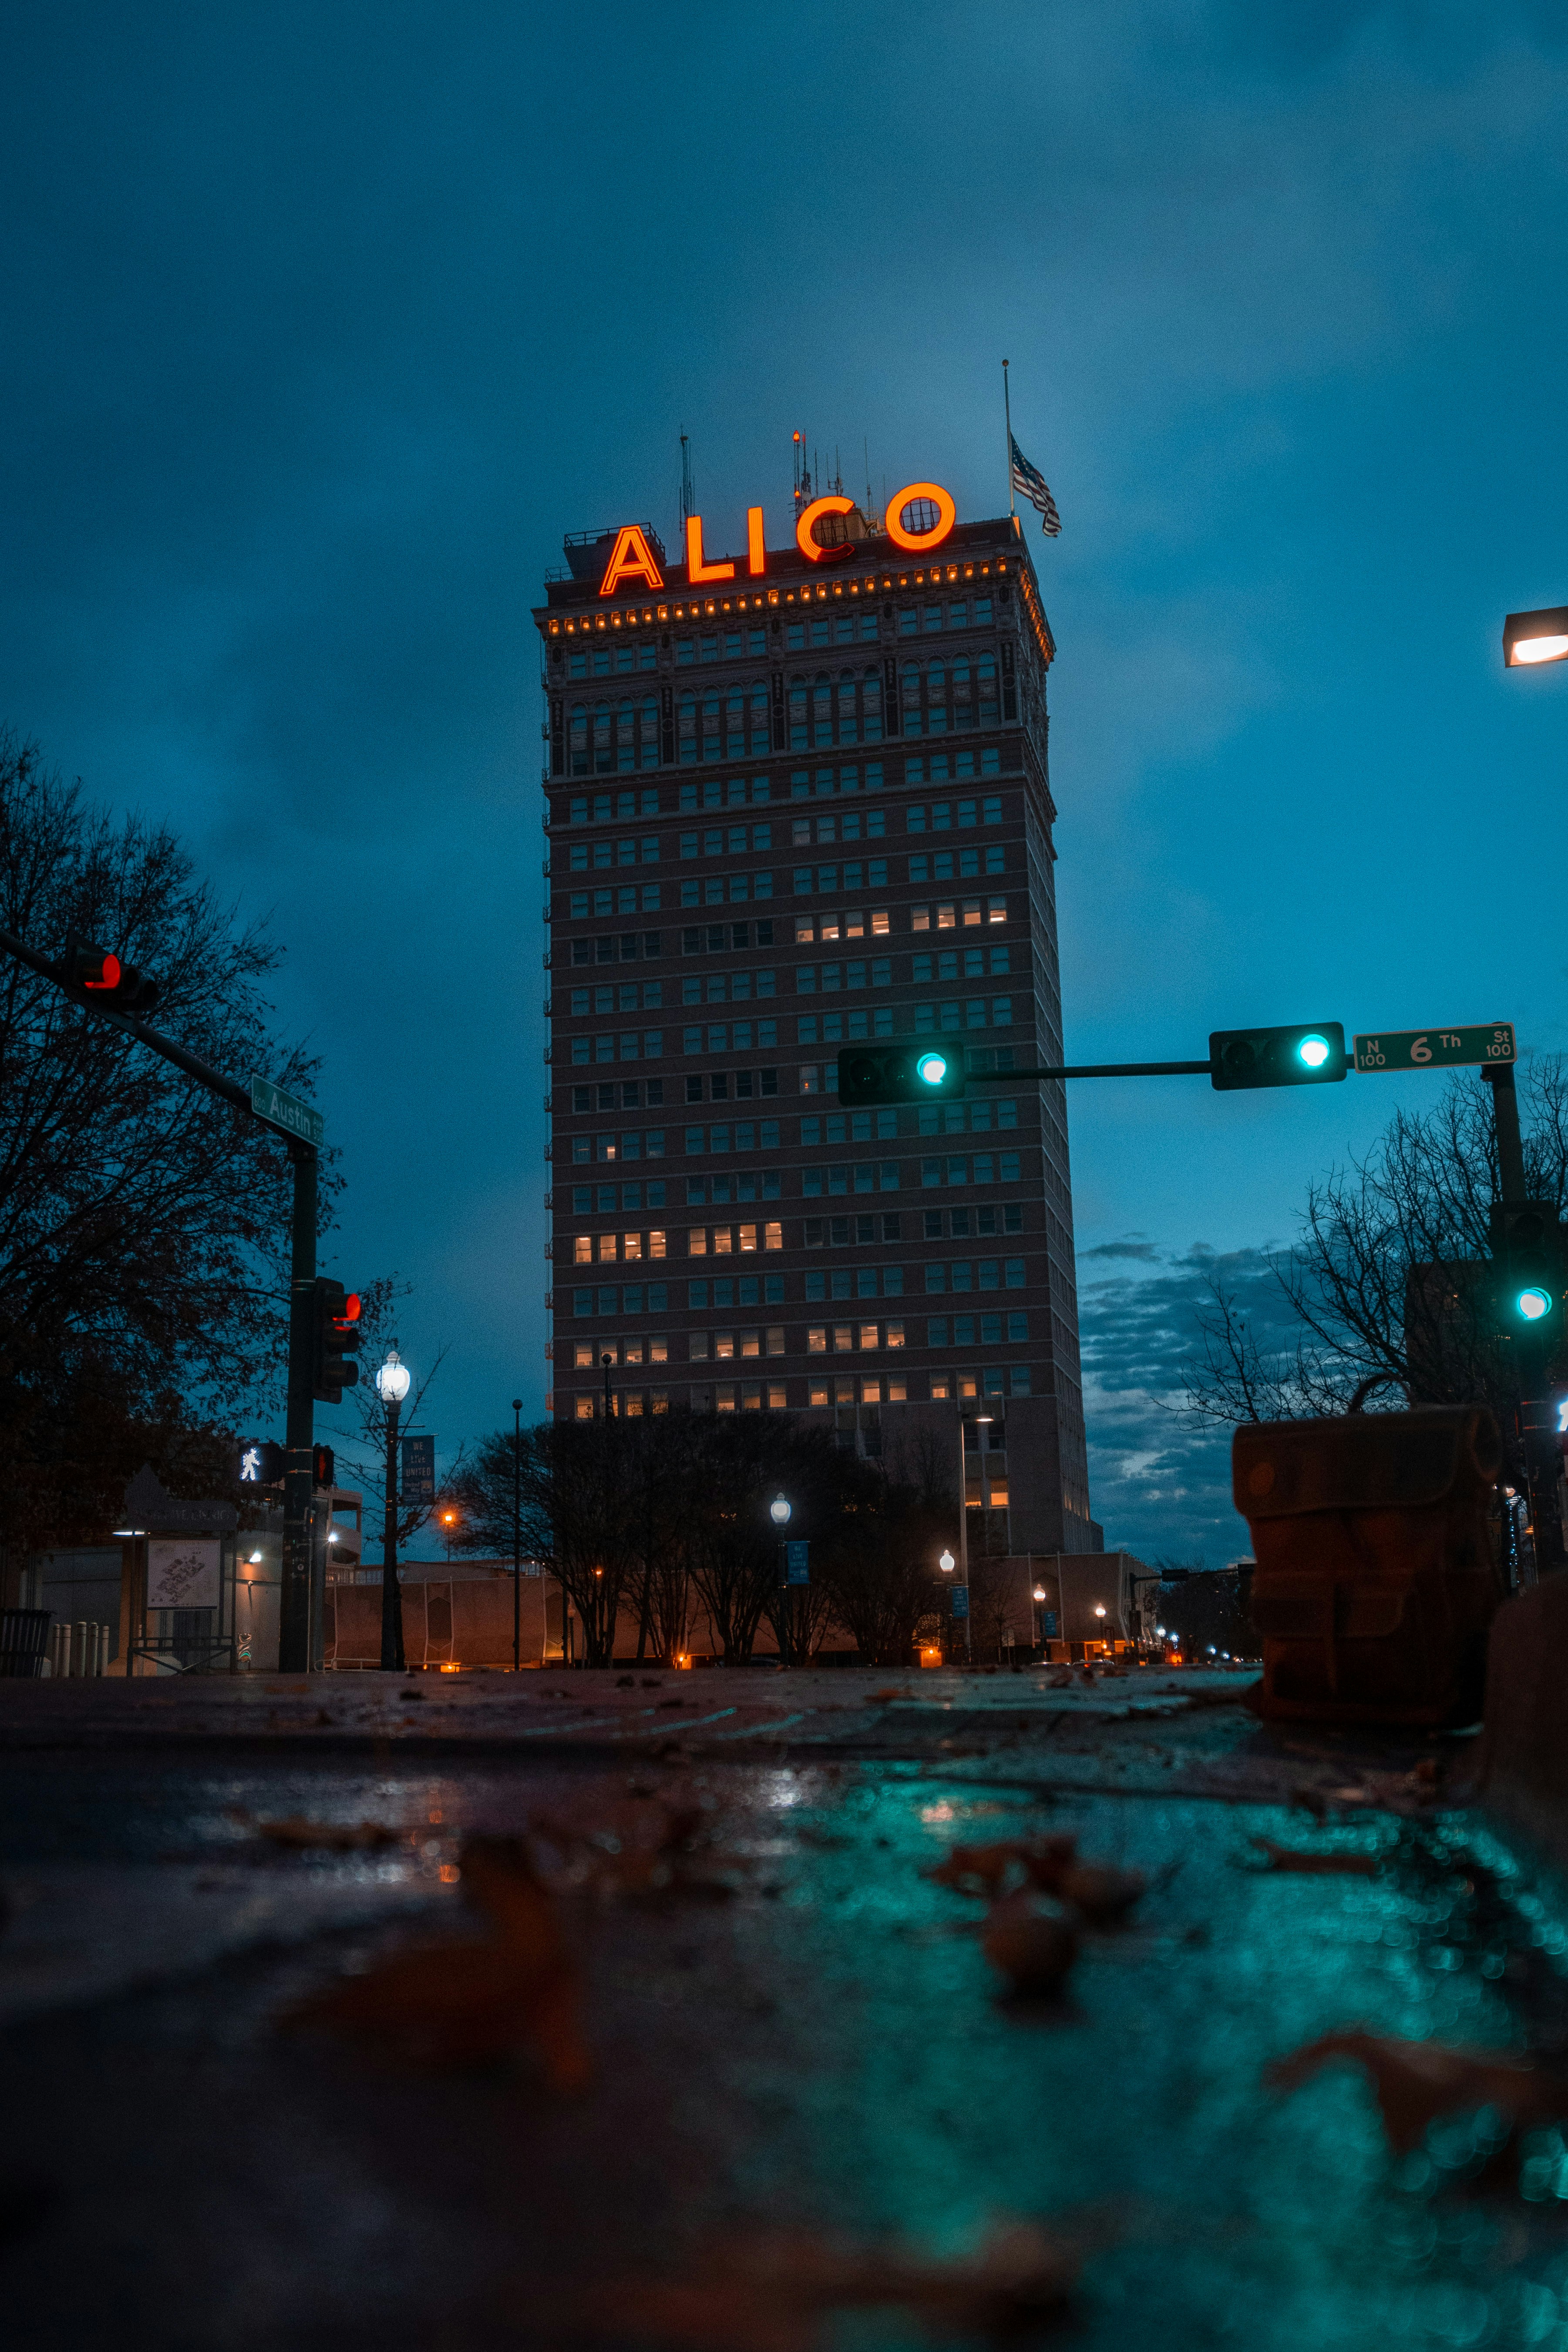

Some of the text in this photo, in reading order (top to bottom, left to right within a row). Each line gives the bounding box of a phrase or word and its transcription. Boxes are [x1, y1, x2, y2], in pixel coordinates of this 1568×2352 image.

[600, 482, 956, 597] ALICO
[1494, 1030, 1510, 1043] St
[1367, 1040, 1379, 1053] N
[1410, 1034, 1461, 1063] 6 Th
[1486, 1044, 1511, 1057] 100
[1360, 1053, 1386, 1067] 100
[269, 1092, 311, 1136] Austin
[413, 1441, 423, 1450] WE
[411, 1454, 426, 1464] LIVE
[406, 1467, 431, 1477] UNITED
